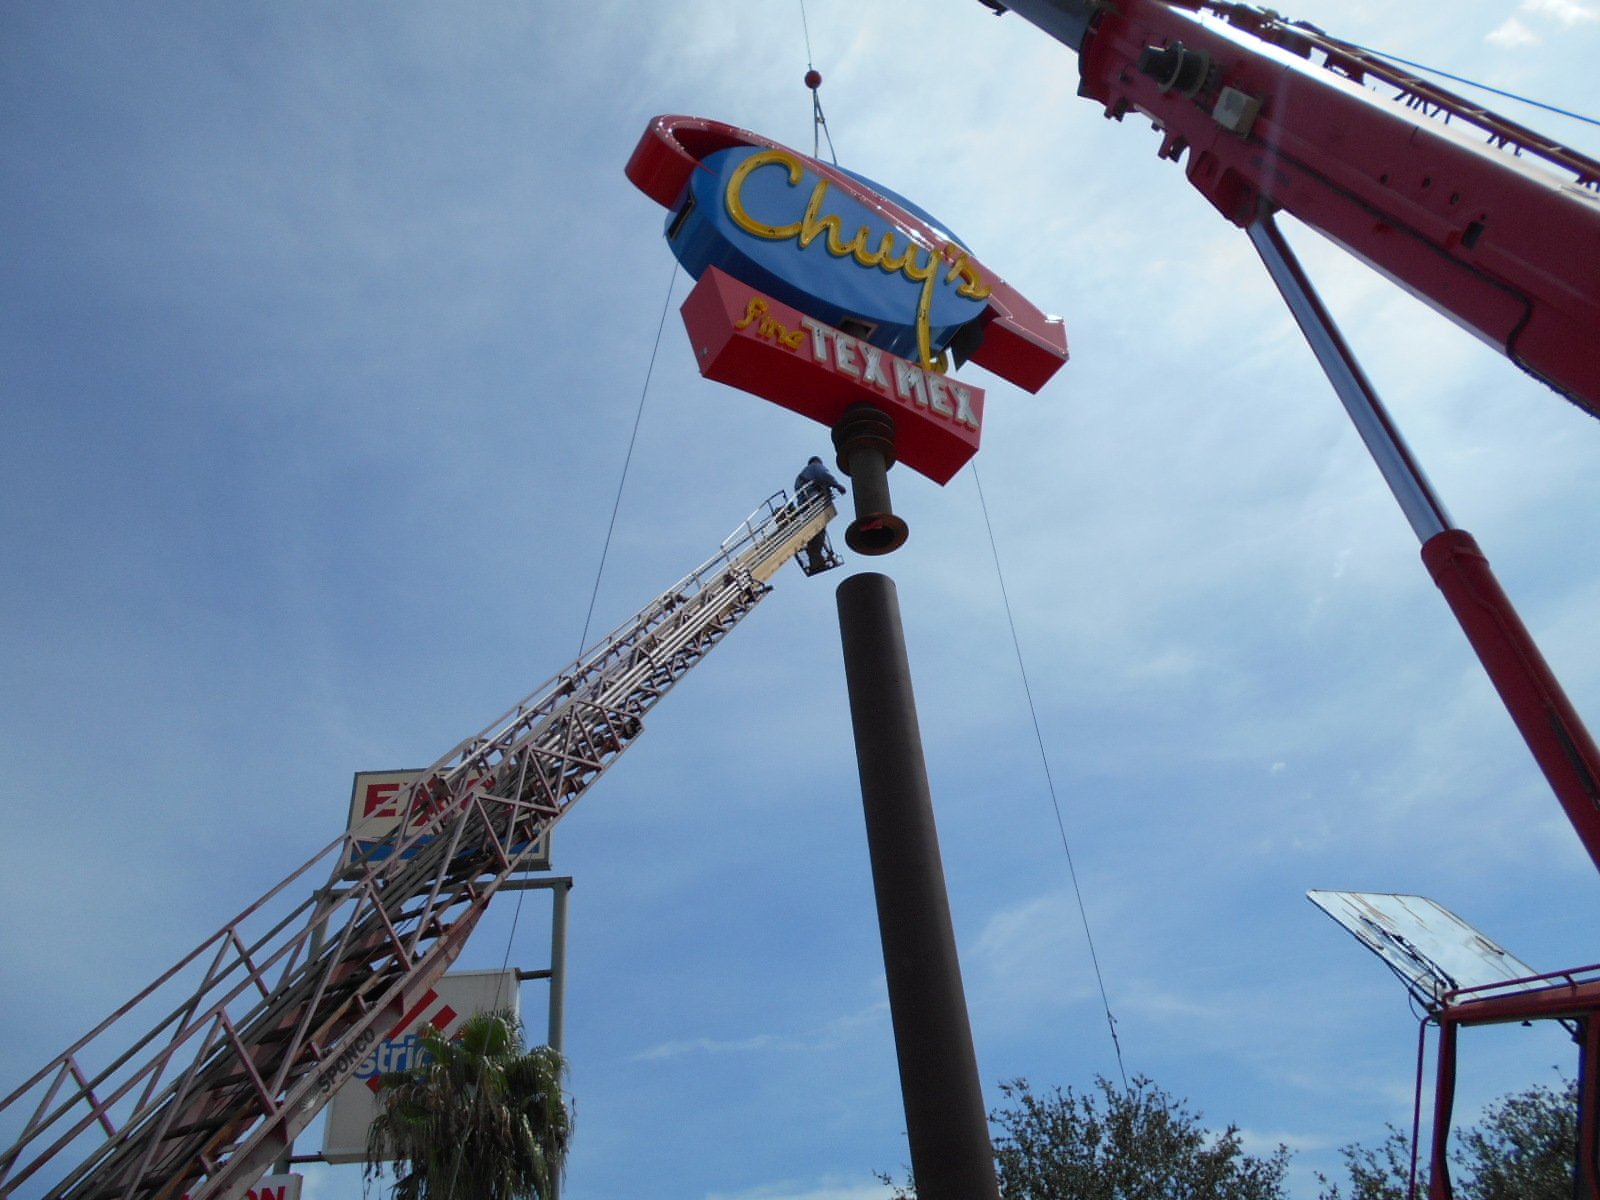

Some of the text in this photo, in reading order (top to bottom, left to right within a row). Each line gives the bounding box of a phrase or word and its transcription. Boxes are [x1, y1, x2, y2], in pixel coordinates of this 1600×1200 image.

[725, 149, 992, 374] Chuy's
[800, 314, 890, 392] TEX
[891, 358, 981, 430] MEX
